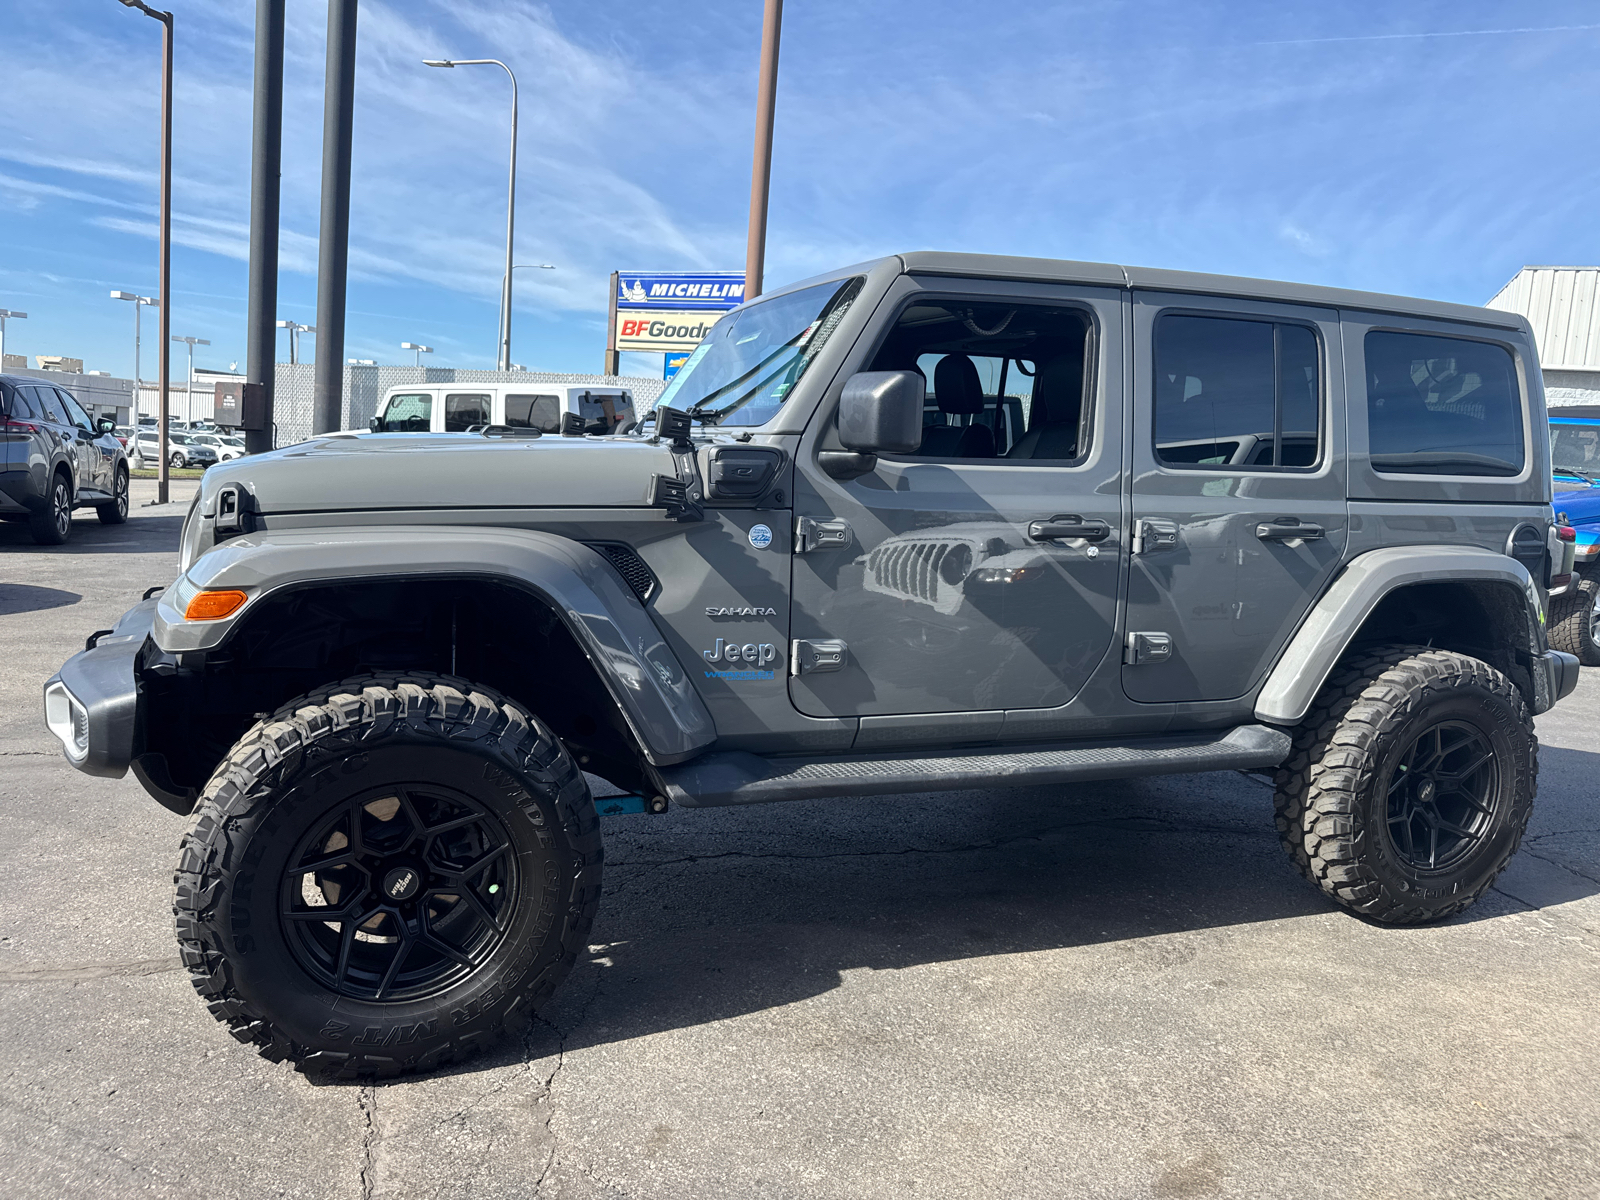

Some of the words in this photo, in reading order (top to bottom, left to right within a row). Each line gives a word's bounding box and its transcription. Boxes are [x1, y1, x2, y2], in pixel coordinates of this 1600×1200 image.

[650, 283, 745, 297] MICHELIN
[621, 319, 713, 338] BFGoodr
[705, 607, 777, 616] SAHARA
[703, 638, 776, 666] Jeep
[481, 761, 557, 850] WIDE
[450, 860, 561, 1028] CLIMBER
[319, 1019, 350, 1041] 2
[351, 1017, 438, 1047] M/T
